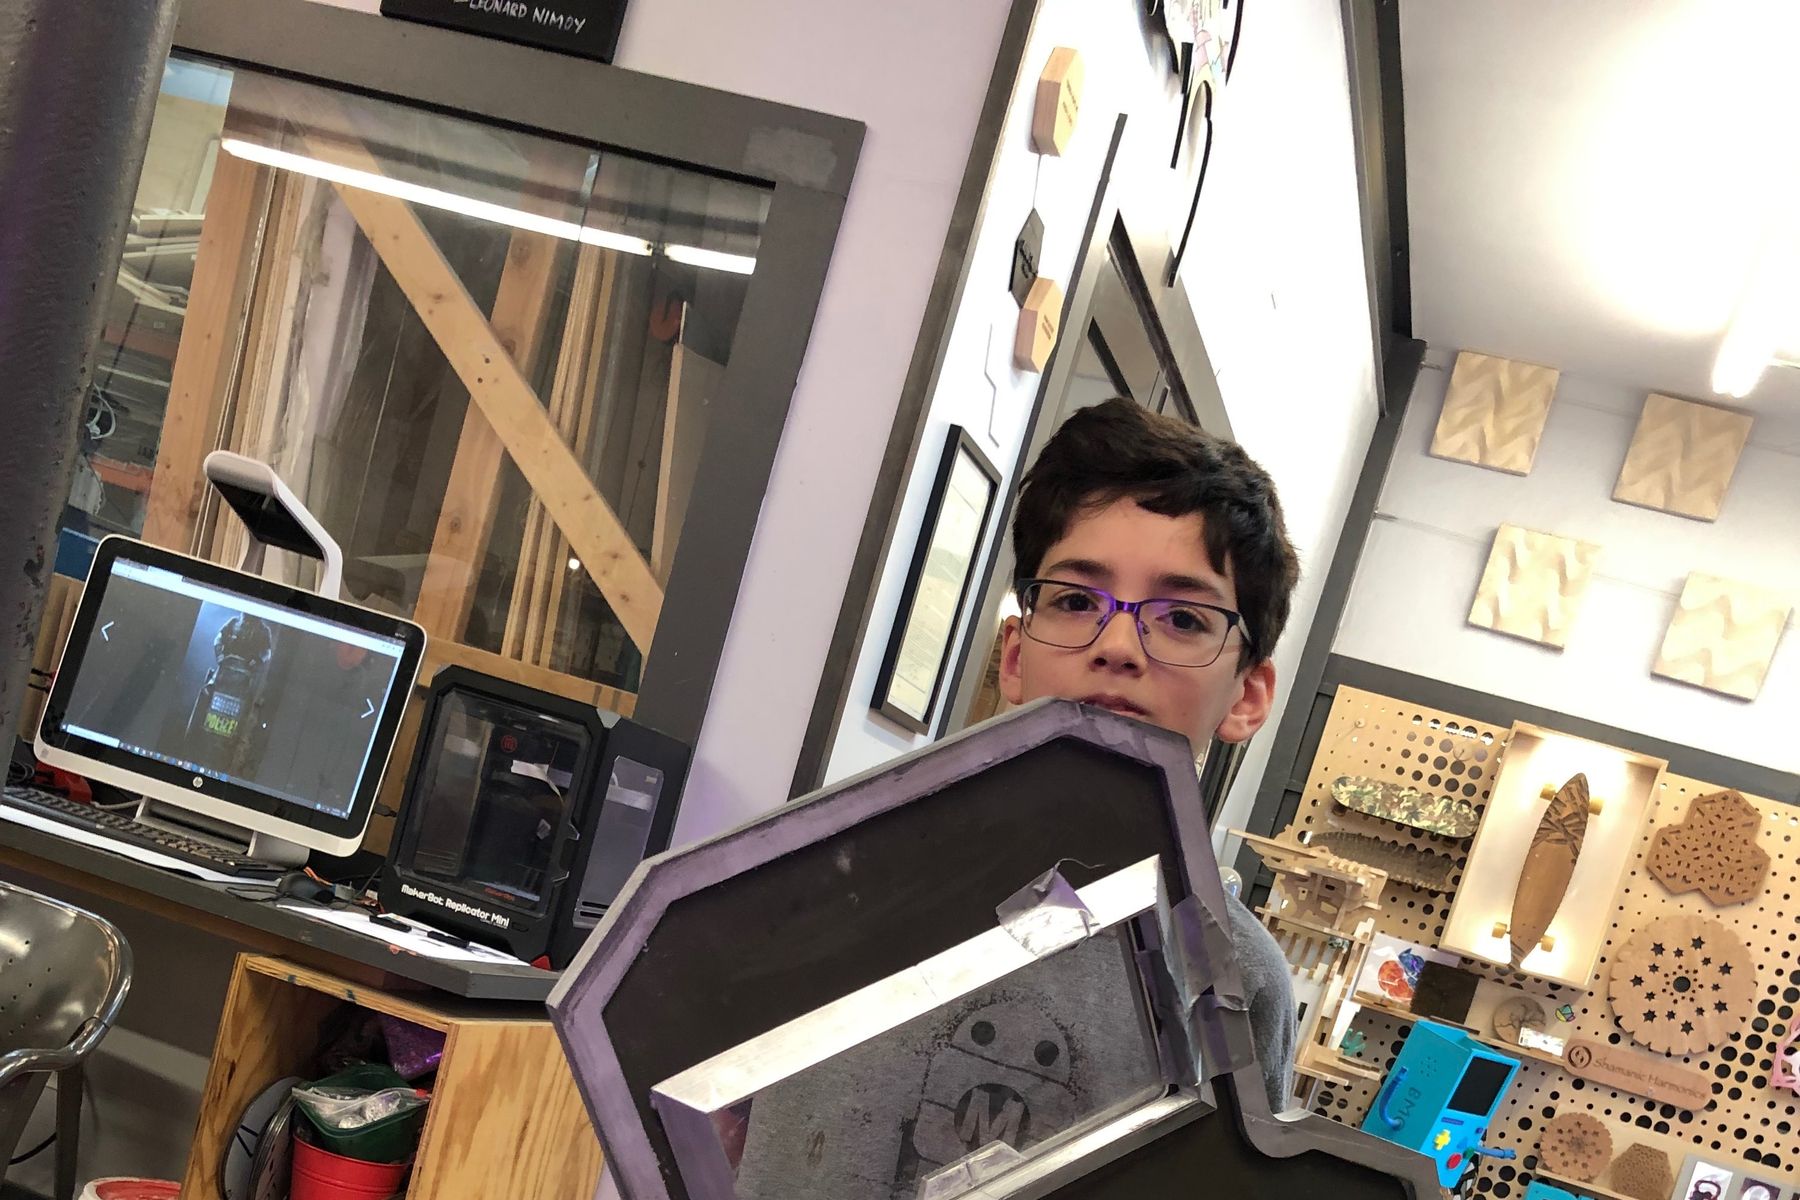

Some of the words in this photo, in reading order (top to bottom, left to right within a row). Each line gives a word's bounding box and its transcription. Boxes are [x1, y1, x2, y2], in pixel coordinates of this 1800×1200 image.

[469, 0, 527, 18] LEONARD
[532, 7, 586, 34] NIMOY
[401, 884, 444, 906] MakerBot
[445, 898, 491, 920] Replicator
[491, 912, 510, 927] Mini
[1592, 1056, 1648, 1082] Shamanic
